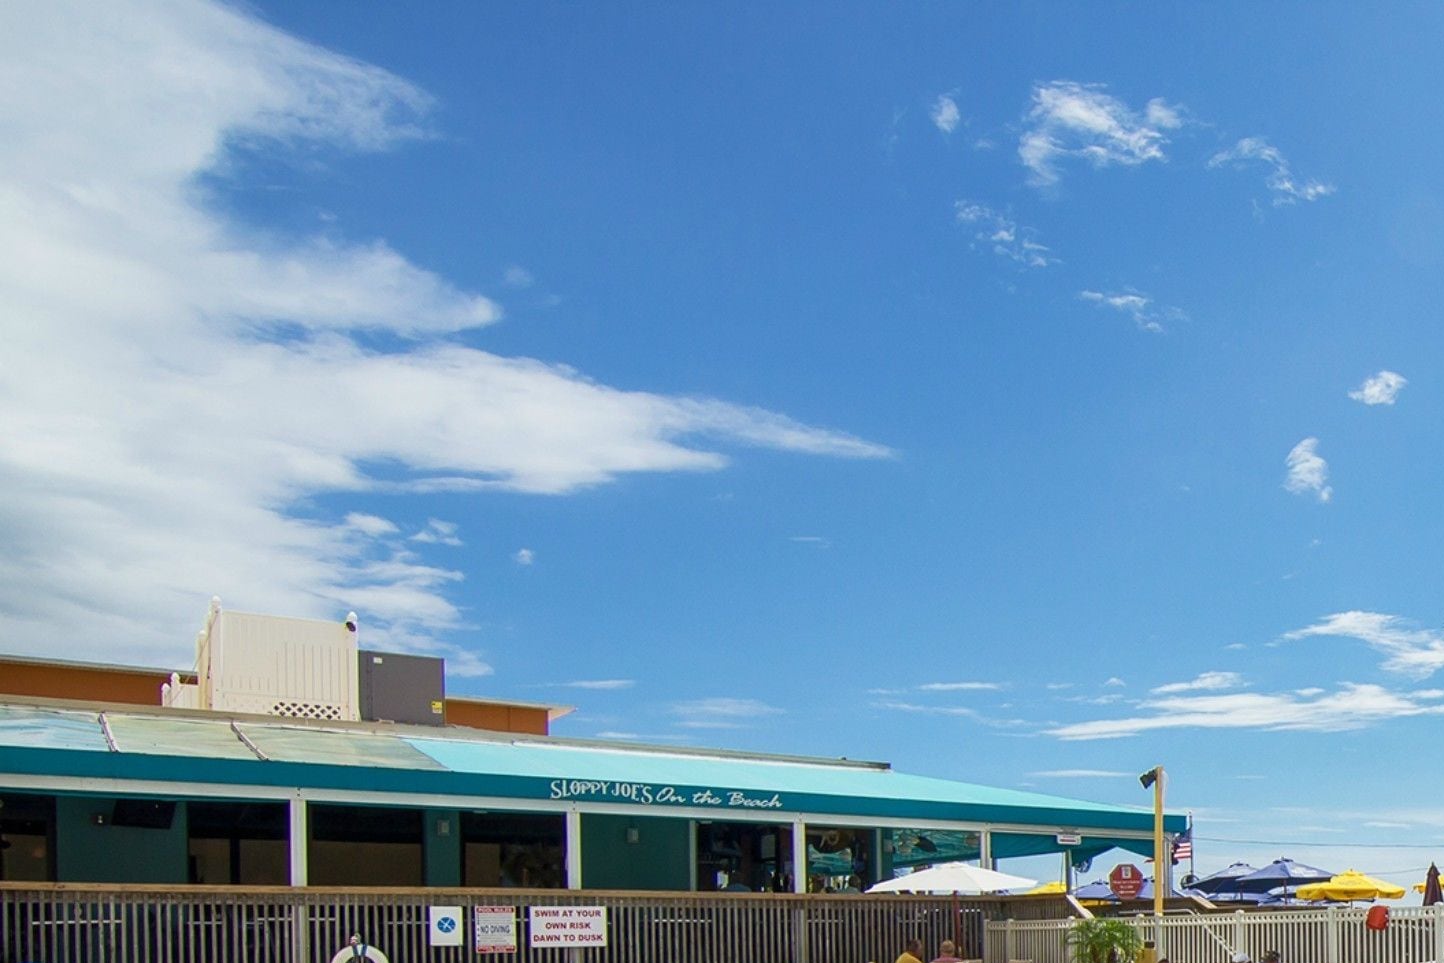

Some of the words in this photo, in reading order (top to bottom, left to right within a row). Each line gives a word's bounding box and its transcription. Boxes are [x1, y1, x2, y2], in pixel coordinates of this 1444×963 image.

[551, 780, 610, 799] SLOPPY
[611, 782, 653, 804] JOE'S
[656, 786, 686, 803] On
[692, 790, 722, 804] the
[726, 791, 783, 808] Beach
[480, 925, 489, 934] NO
[491, 924, 511, 934] DIVING
[545, 922, 567, 930] OWN
[533, 934, 560, 942] DAWN
[578, 934, 603, 942] DUSK
